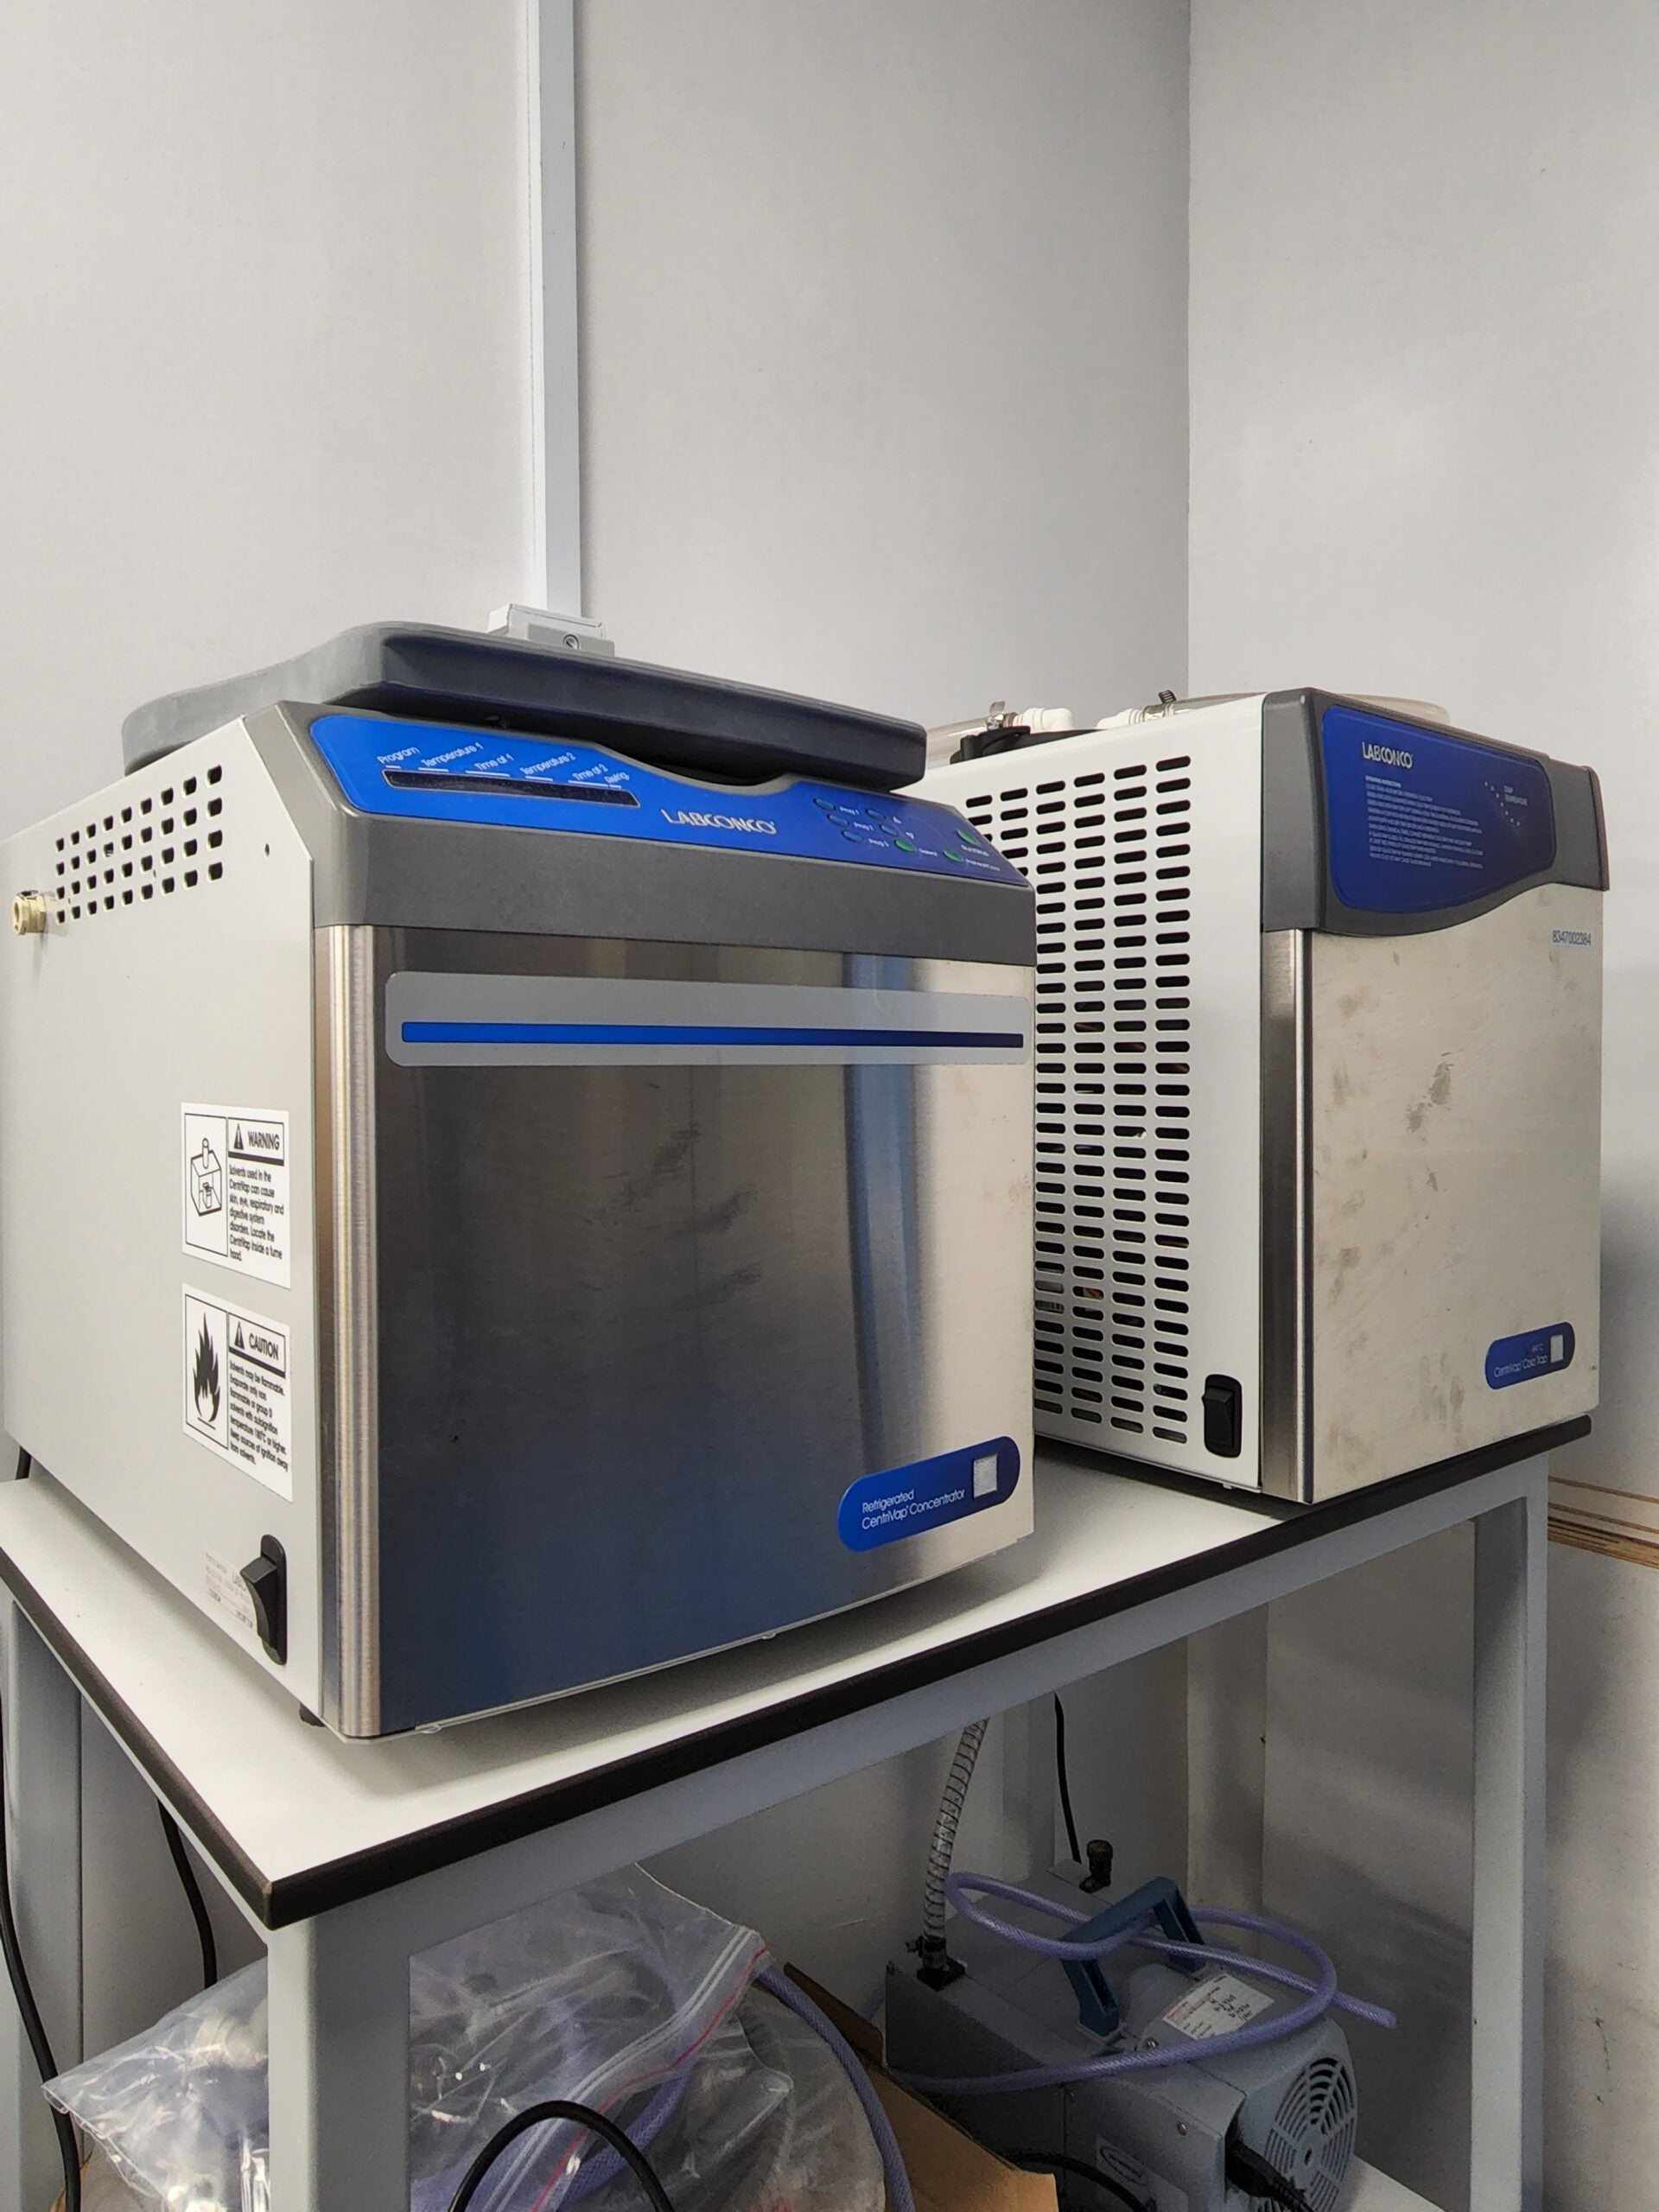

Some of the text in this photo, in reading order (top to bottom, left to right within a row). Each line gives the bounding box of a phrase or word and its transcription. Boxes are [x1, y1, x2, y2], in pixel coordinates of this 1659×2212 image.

[377, 747, 420, 765] Program
[421, 745, 478, 766] Temperature
[474, 760, 499, 771] Time
[505, 753, 515, 761] 1
[519, 752, 576, 775] Temperature 2
[1362, 741, 1413, 769] LABCONCO
[572, 769, 592, 781] Time
[600, 763, 609, 773] 2
[660, 808, 777, 836] LABCONCO
[247, 1131, 280, 1151] WARNING
[251, 1185, 259, 1195] can
[274, 1204, 284, 1216] and
[249, 1332, 279, 1361] CAUTION
[861, 1489, 915, 1514] Refrigerated
[909, 1488, 965, 1516] Concentrator
